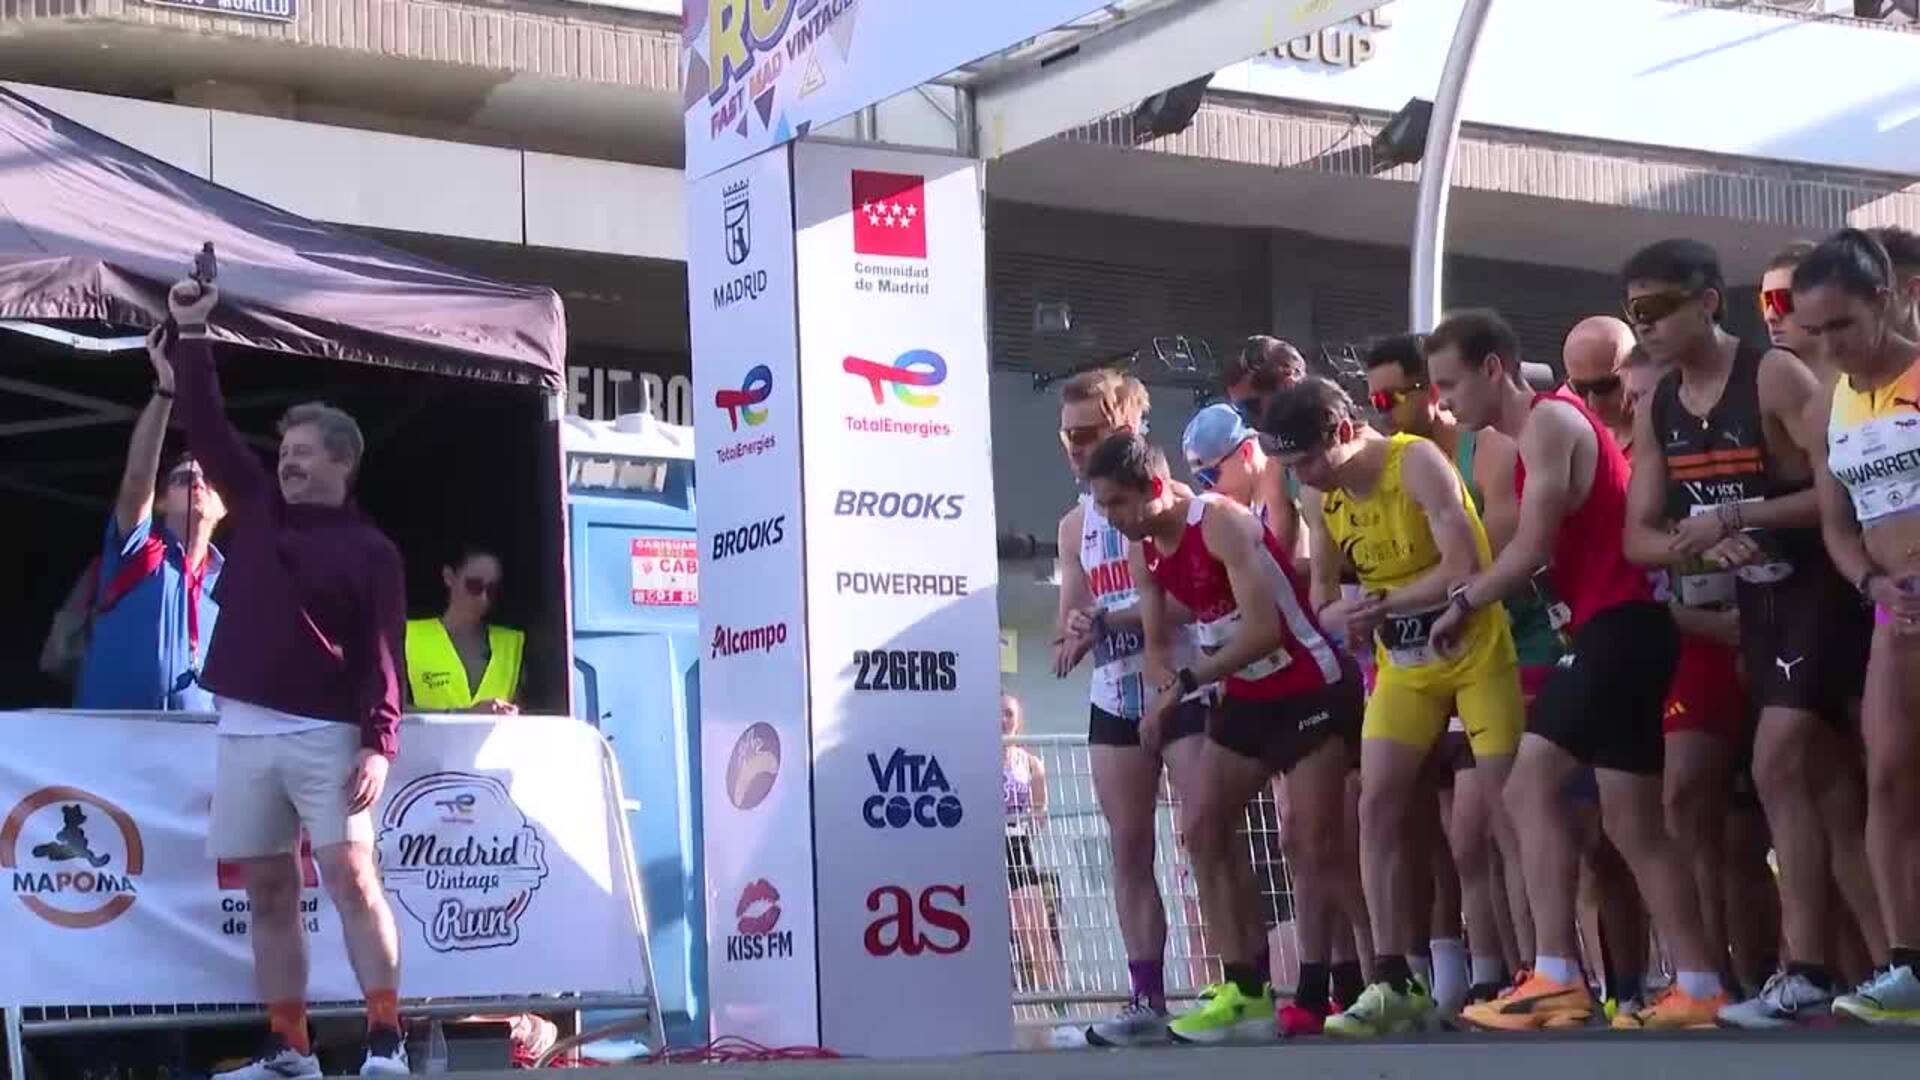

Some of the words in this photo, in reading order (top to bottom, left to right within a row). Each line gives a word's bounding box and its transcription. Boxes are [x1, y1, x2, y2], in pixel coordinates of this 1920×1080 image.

[711, 87, 745, 140] FAST
[854, 262, 930, 280] Comunidad
[713, 269, 768, 312] MADRID
[854, 280, 873, 293] de
[878, 280, 930, 296] Madrid
[845, 416, 951, 439] TotalEnergies
[716, 433, 777, 465] TotalEnergies
[834, 489, 966, 520] BROOKS
[712, 514, 786, 560] BROOKS
[836, 571, 968, 597] POWERADE
[711, 621, 788, 659] Alcampo
[1396, 618, 1425, 643] 22
[853, 649, 957, 692] 226ERS
[866, 746, 951, 794] VITA
[862, 794, 963, 829] COCO
[399, 834, 520, 867] Madrid
[13, 871, 137, 894] MAPOMA
[426, 868, 499, 895] Vintage
[222, 918, 248, 935] de
[432, 896, 512, 943] Run
[863, 883, 971, 957] as
[727, 935, 764, 962] KISS
[767, 930, 793, 960] FM
